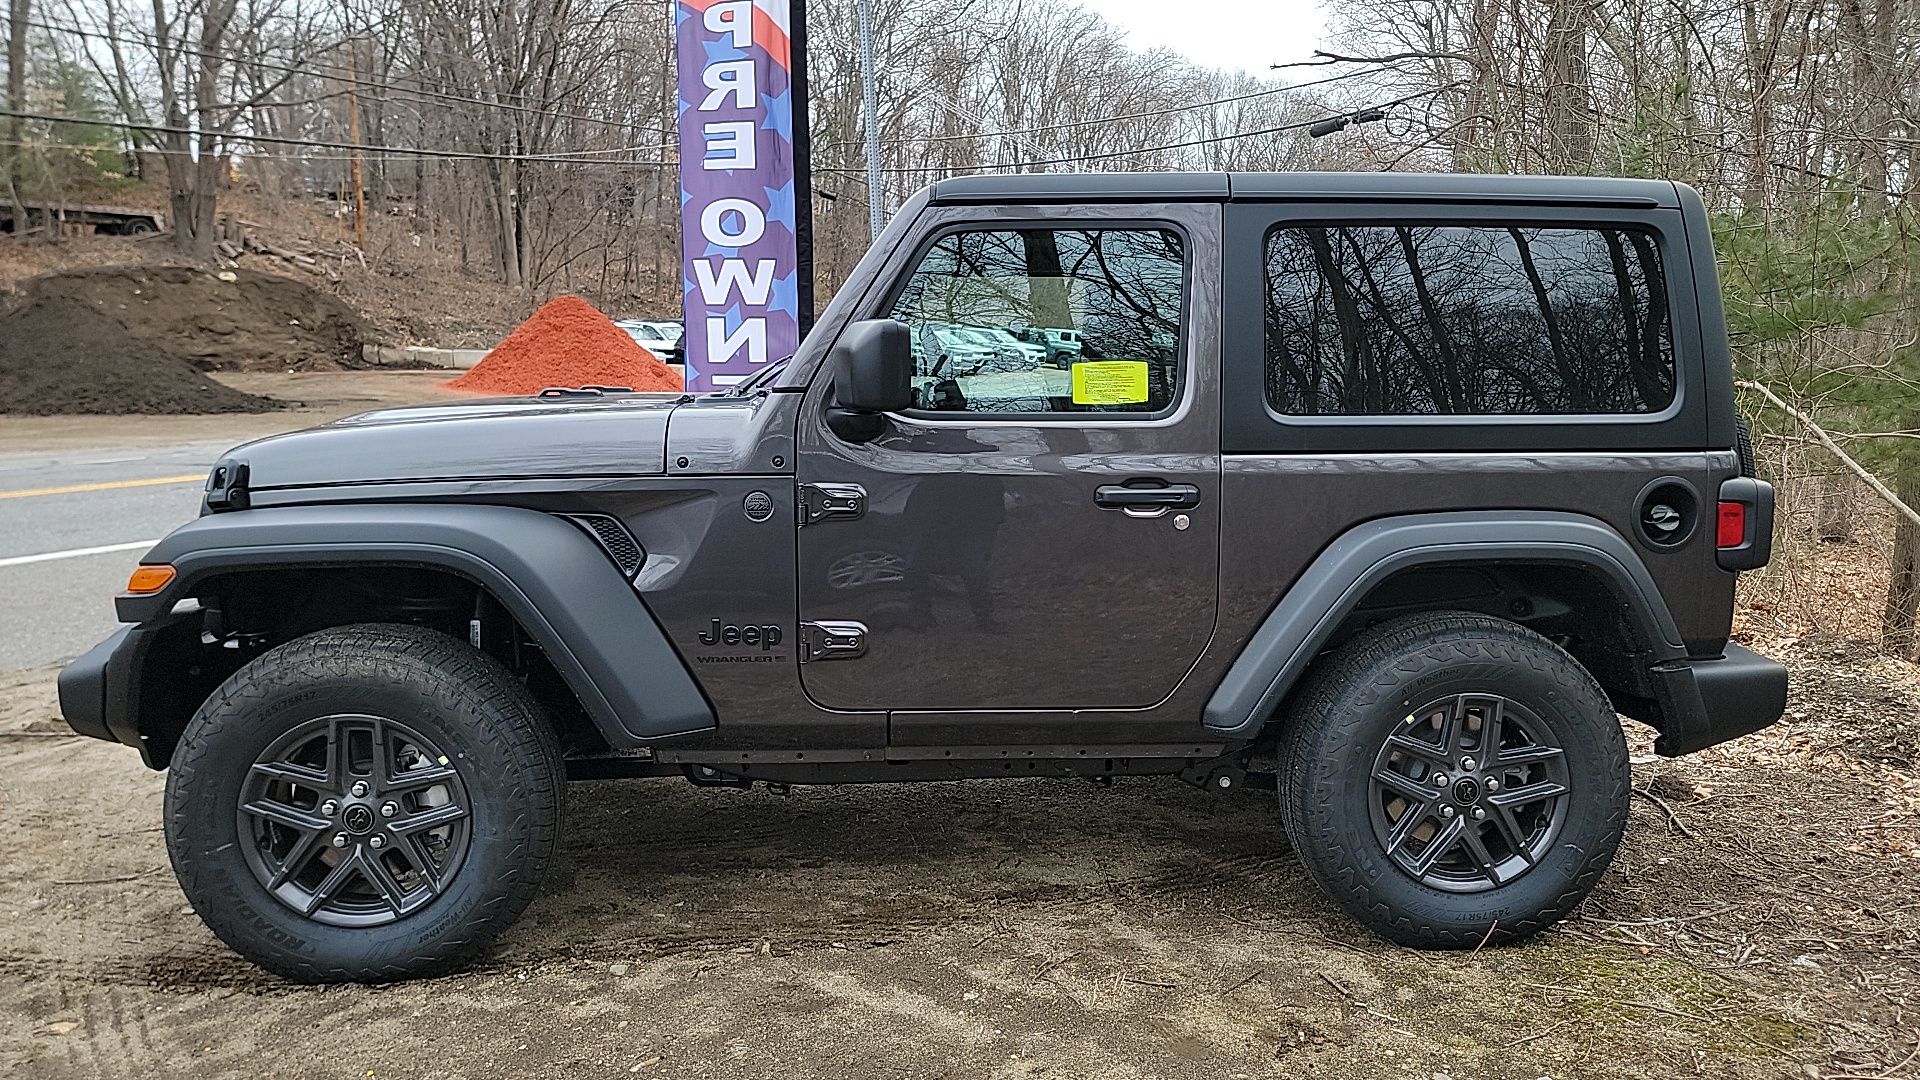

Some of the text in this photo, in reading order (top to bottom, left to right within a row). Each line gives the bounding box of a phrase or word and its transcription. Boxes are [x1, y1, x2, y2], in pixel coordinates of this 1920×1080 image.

[698, 618, 782, 650] Jeep
[696, 655, 774, 664] WRANGLER
[257, 691, 316, 721] 245/75R17
[1455, 905, 1512, 922] 245/75R17
